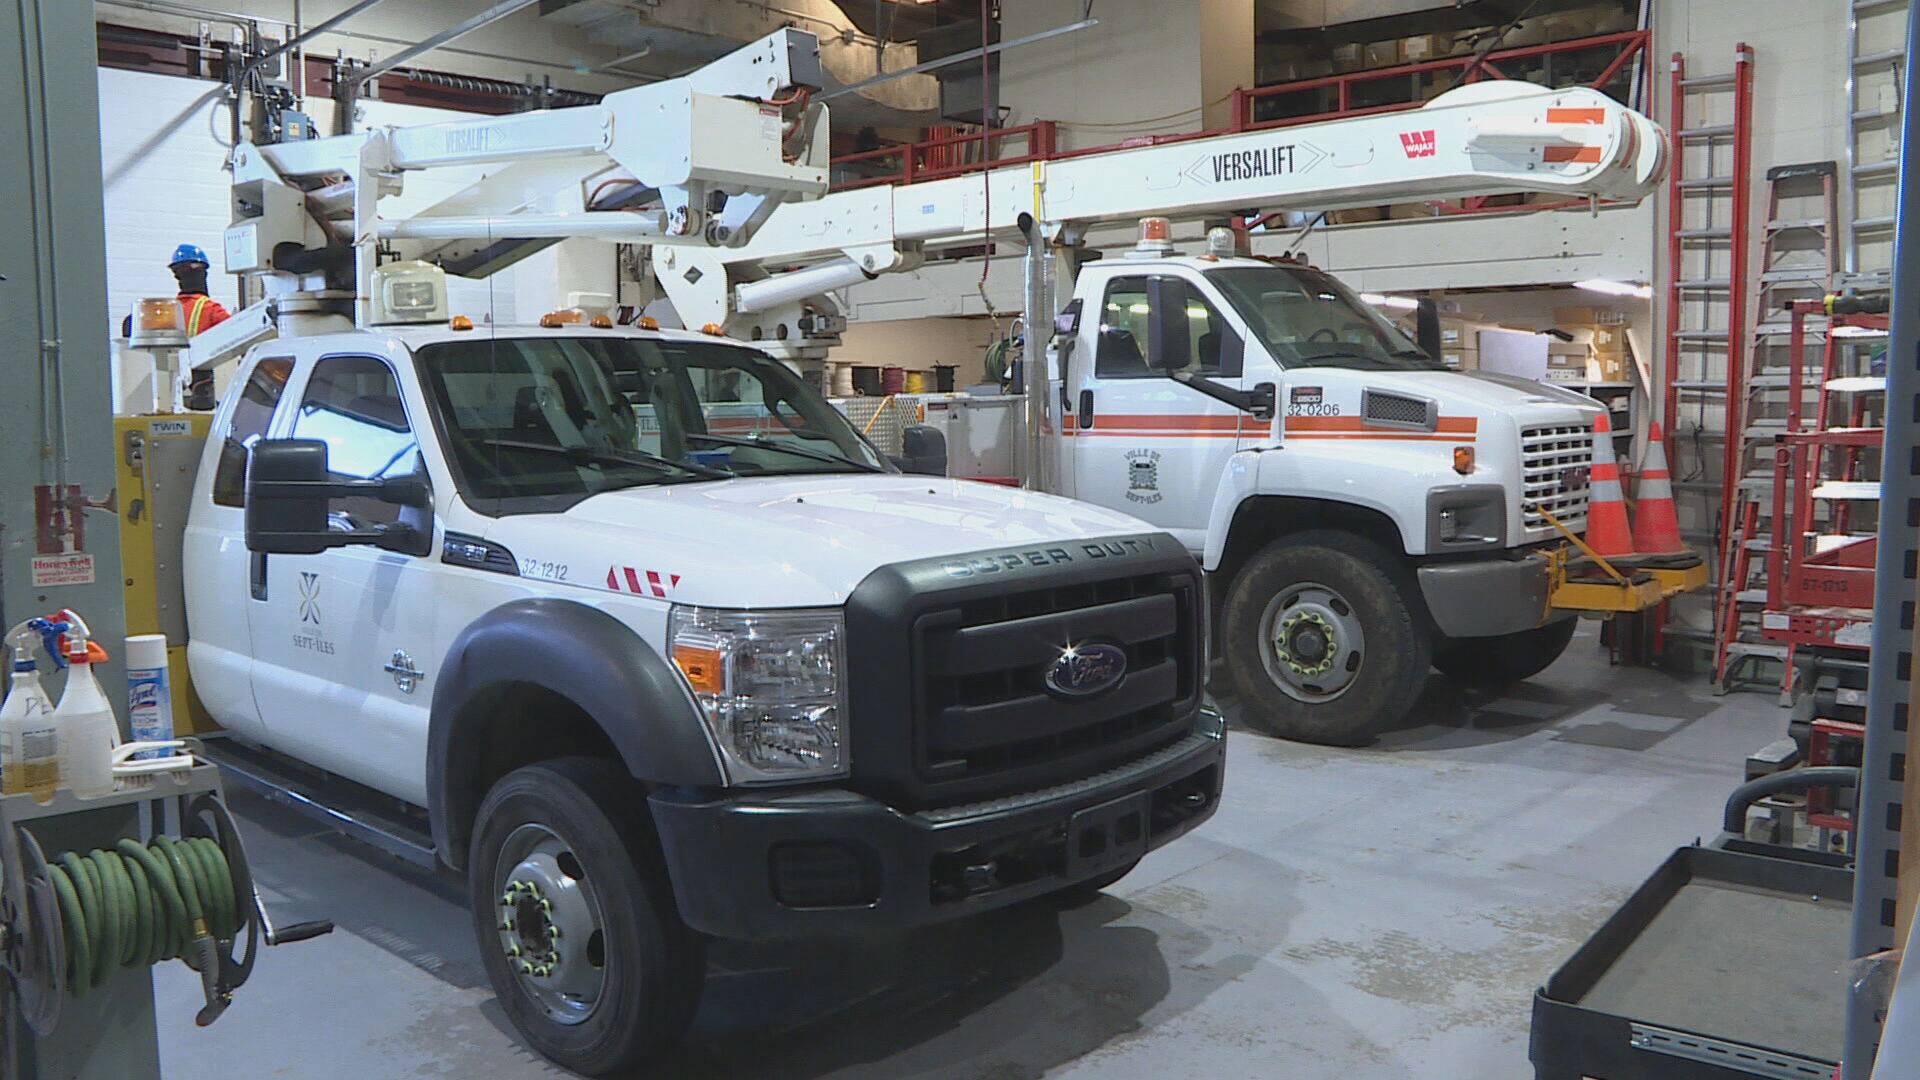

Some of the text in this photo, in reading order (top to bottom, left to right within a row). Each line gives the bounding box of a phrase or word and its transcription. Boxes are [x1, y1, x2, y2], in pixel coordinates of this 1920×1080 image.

[1406, 141, 1433, 154] WAJAX
[1213, 145, 1295, 182] VERSALIFT
[152, 422, 186, 432] TWIN
[1123, 448, 1149, 460] VILLE
[33, 557, 92, 570] Honeywell
[941, 537, 1157, 577] SUPER DUTY
